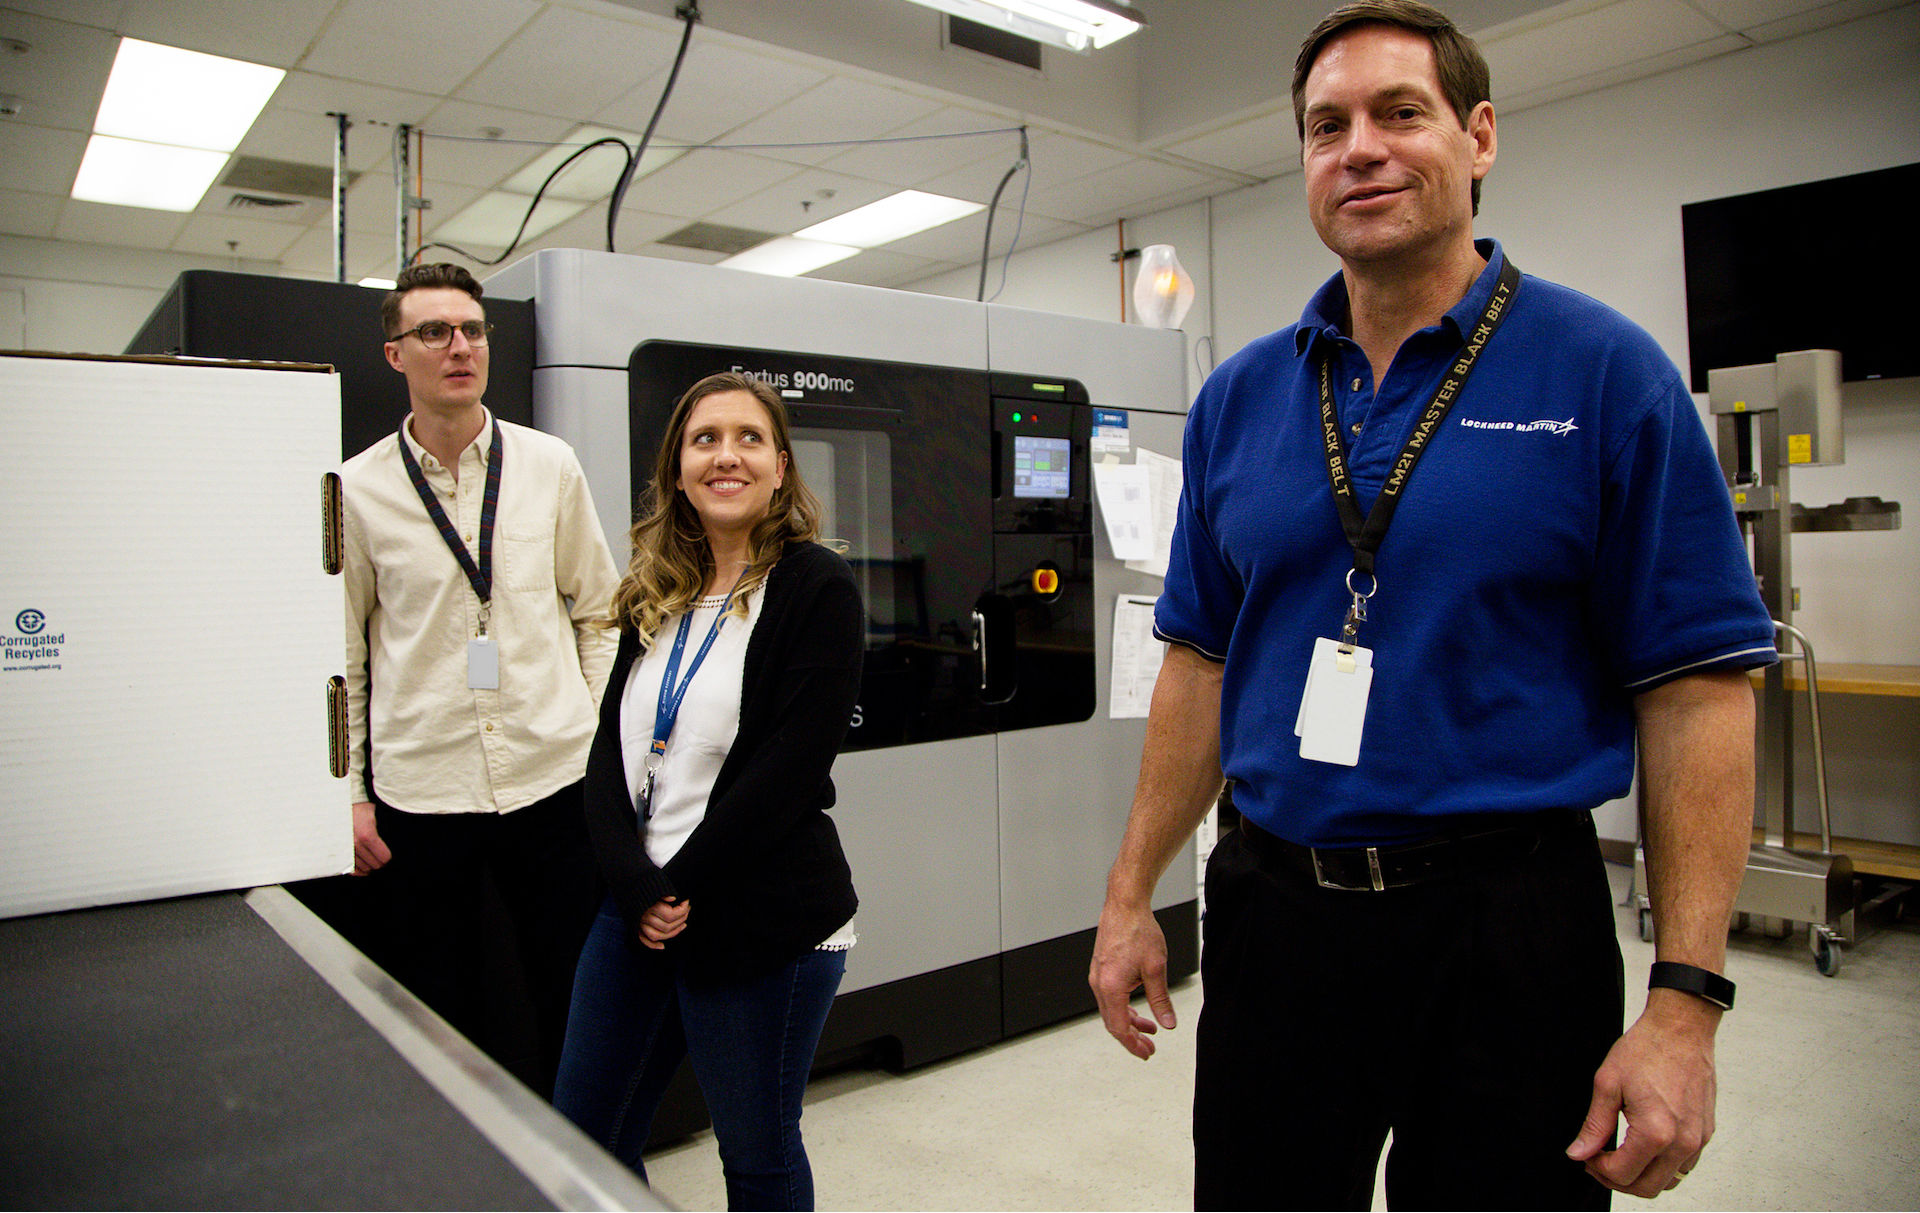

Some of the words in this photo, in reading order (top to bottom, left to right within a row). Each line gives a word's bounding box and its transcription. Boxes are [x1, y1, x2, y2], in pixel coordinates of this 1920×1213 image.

[793, 371, 855, 392] 900mc
[1384, 453, 1415, 496] LM21
[1409, 378, 1459, 449] MASTER
[1453, 323, 1492, 376] BLACK
[1486, 283, 1510, 322] BELT
[1322, 402, 1339, 453] BLACK
[1461, 418, 1514, 430] LOCKHEED
[1516, 422, 1558, 432] MARTIN
[1329, 456, 1350, 497] BELT
[0, 633, 65, 647] Corrugated
[5, 647, 60, 660] Recycles
